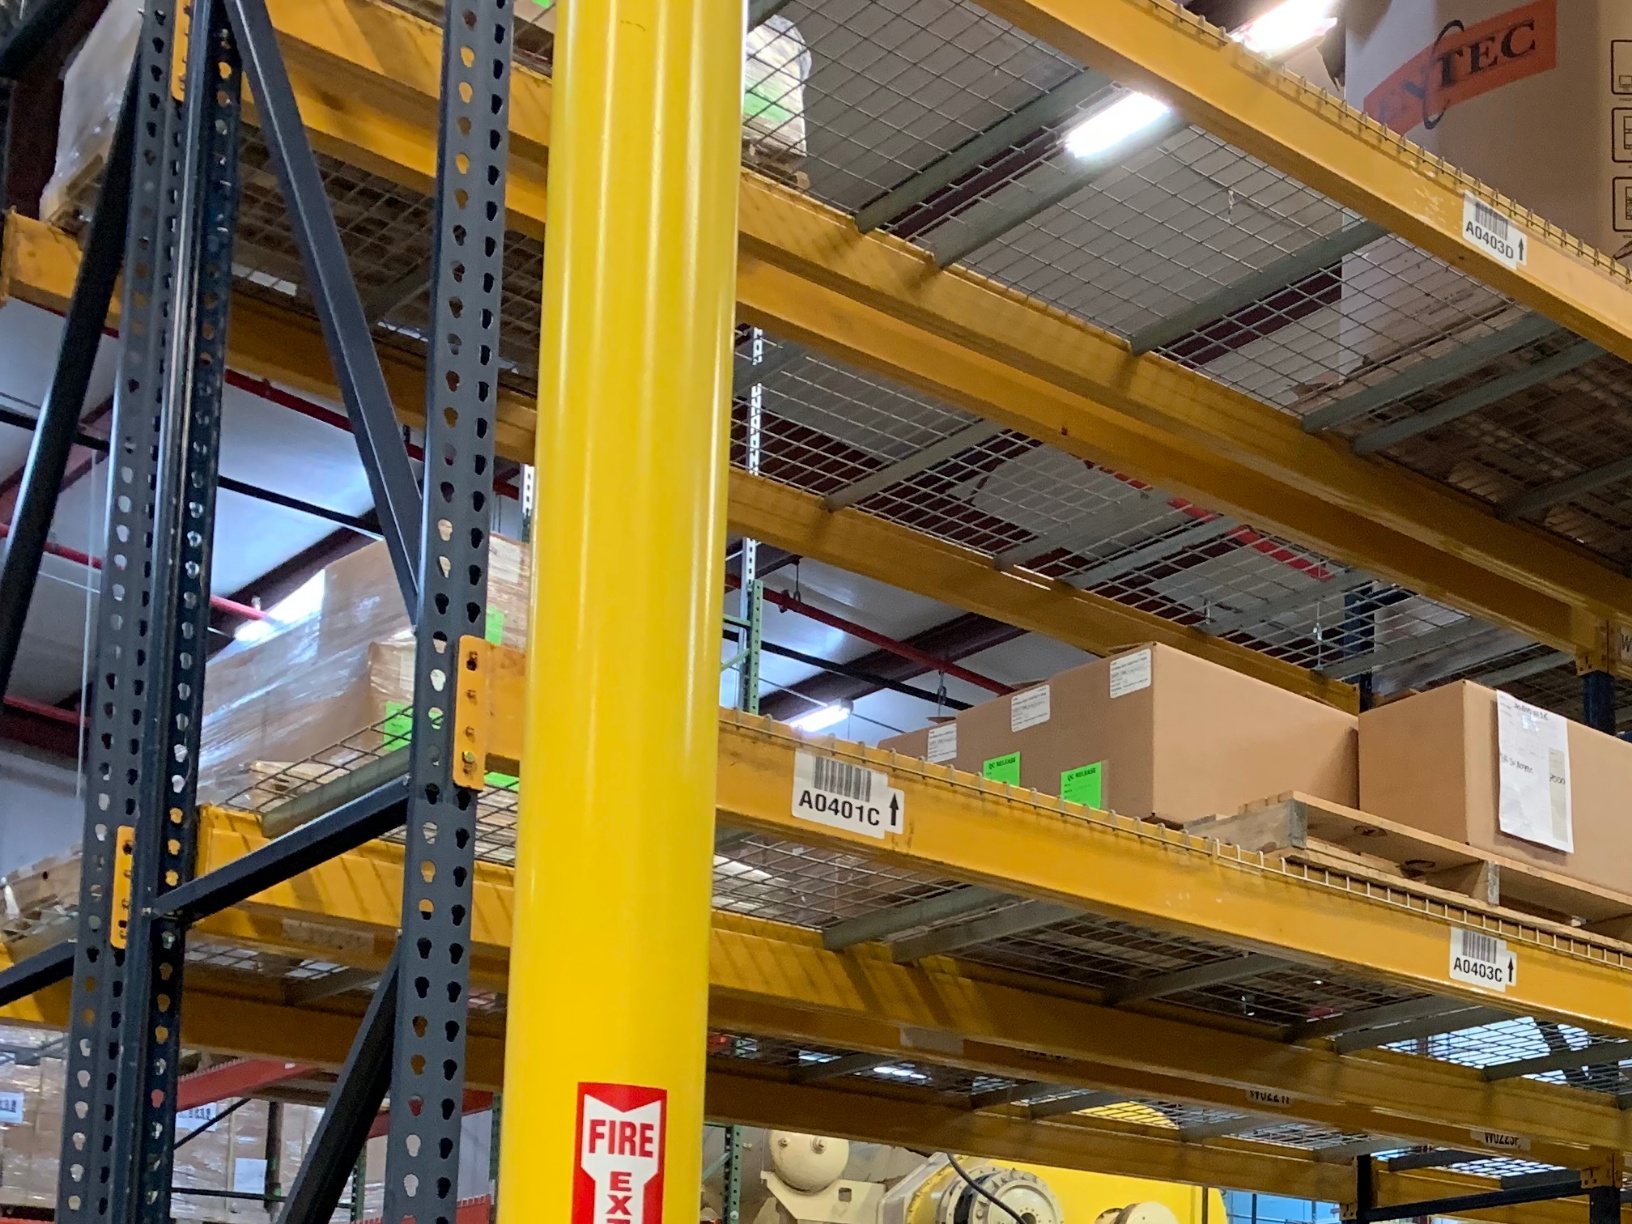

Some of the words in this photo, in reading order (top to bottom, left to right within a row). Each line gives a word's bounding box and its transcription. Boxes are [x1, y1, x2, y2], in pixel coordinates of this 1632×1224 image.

[1465, 220, 1514, 260] A0403D
[997, 756, 1016, 768] RELEASE
[1075, 766, 1096, 778] RELEASE
[799, 790, 880, 827] A0401C
[1453, 956, 1503, 983] A0403C
[588, 1119, 654, 1158] FIRE
